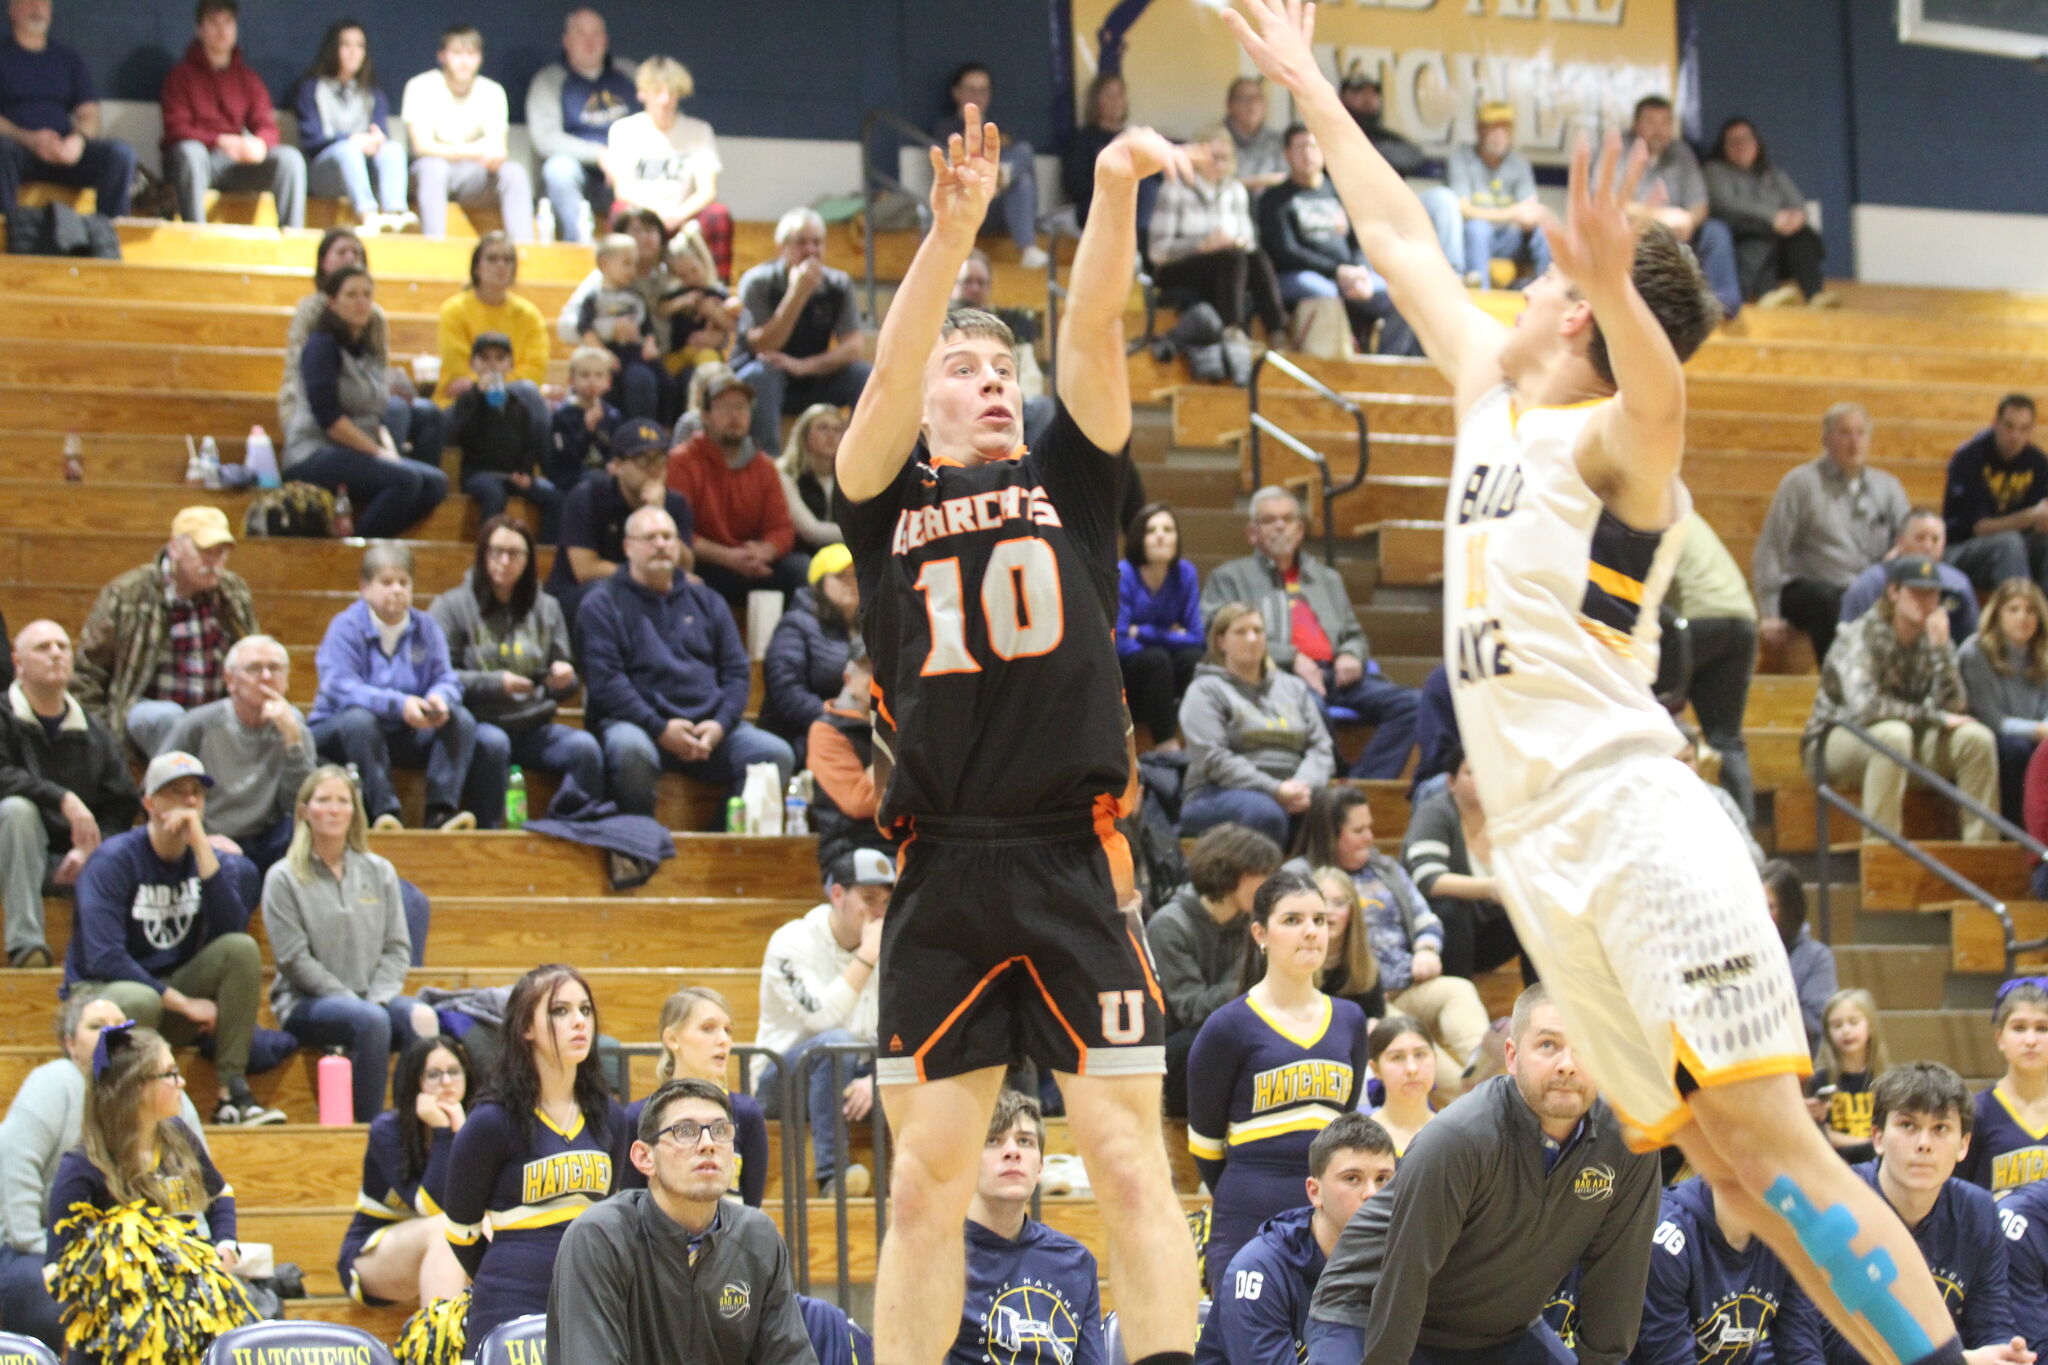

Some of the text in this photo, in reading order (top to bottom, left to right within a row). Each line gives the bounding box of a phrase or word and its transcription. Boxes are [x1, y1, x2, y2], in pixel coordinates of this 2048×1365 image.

[912, 536, 1065, 677] 10
[1097, 990, 1145, 1045] U
[1235, 1270, 1264, 1300] DG
